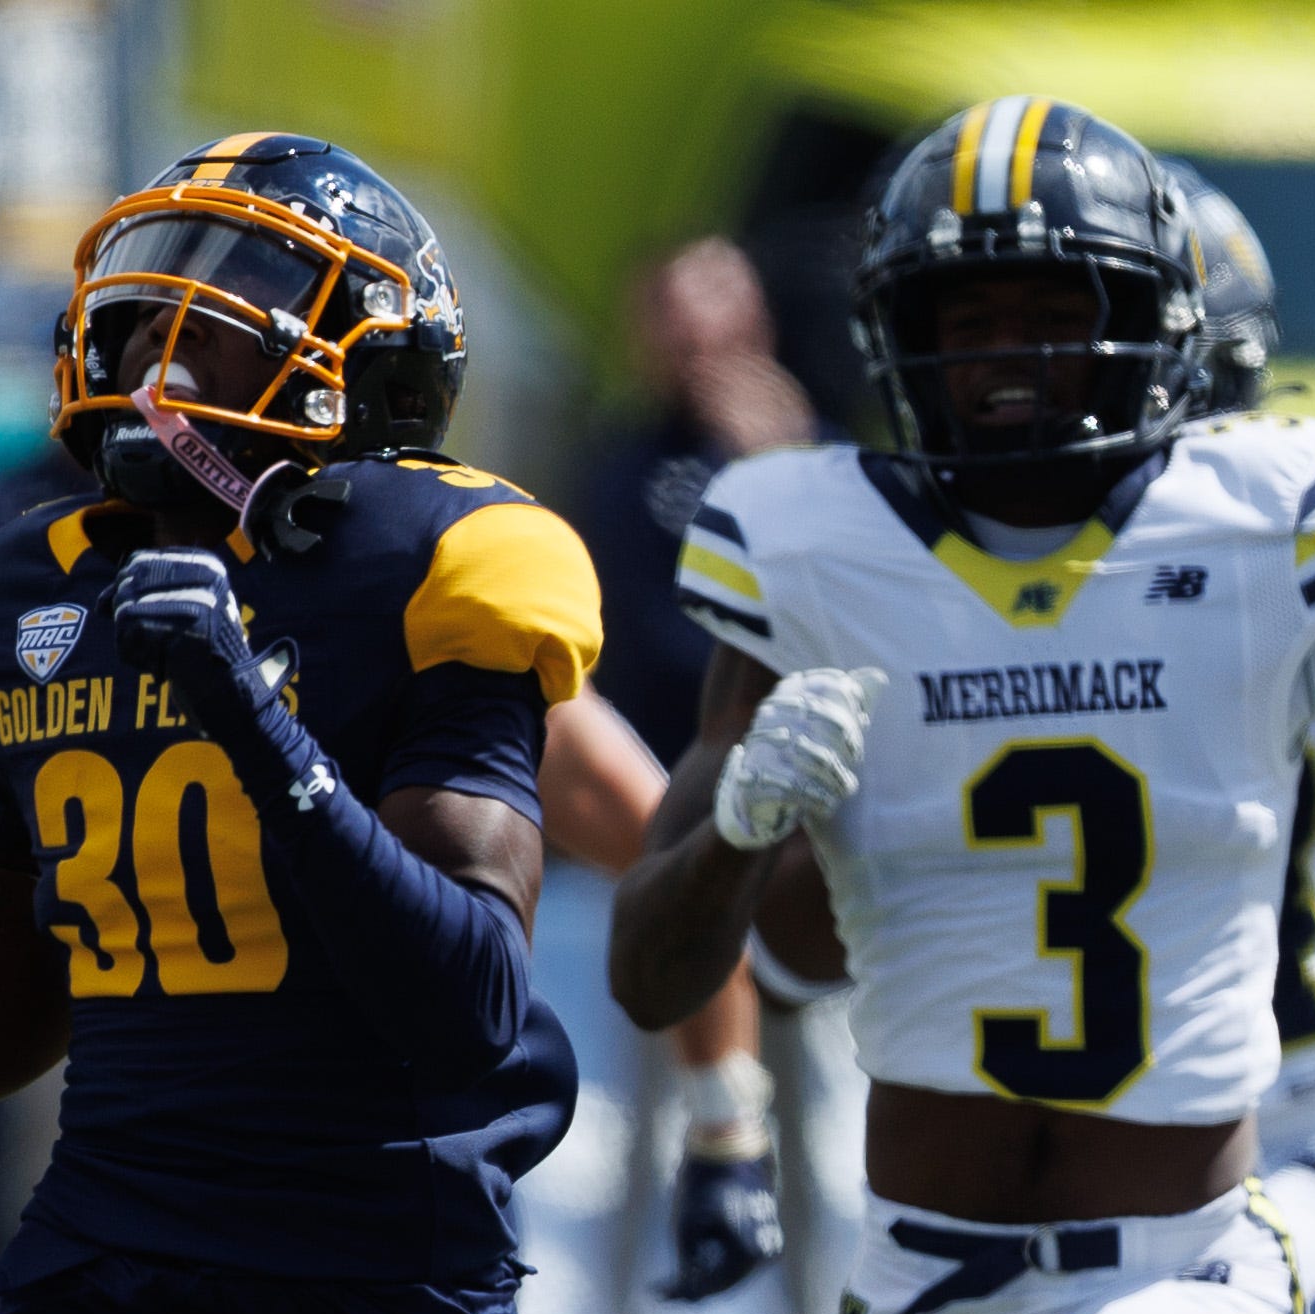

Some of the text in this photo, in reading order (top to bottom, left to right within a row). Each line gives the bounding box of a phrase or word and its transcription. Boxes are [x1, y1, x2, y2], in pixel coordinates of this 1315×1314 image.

[115, 426, 157, 441] Ridde
[179, 436, 252, 502] BATTLE
[19, 625, 77, 648] MAC
[918, 659, 1168, 725] MERRIMACK
[34, 741, 288, 998] 30
[962, 736, 1155, 1110] 3
